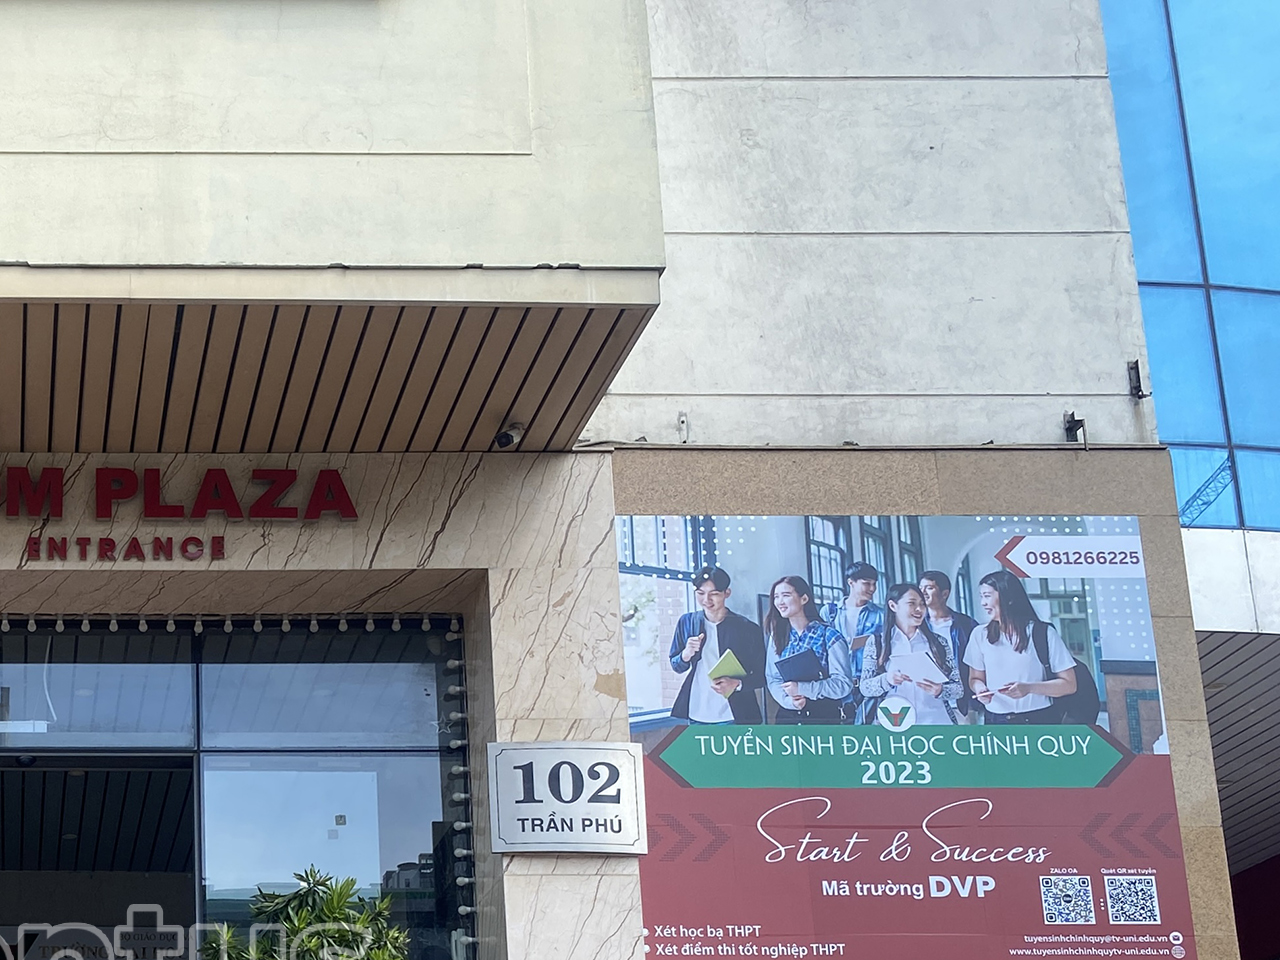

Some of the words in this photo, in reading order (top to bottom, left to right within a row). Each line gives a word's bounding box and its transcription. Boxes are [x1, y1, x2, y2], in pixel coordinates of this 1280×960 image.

[96, 467, 358, 521] PLAZA
[28, 536, 225, 560] ENTRANCE
[1026, 551, 1140, 565] 0981266225
[695, 728, 773, 755] TUYỂN
[781, 736, 834, 755] SINH
[841, 736, 882, 759] ĐẠI
[889, 736, 946, 759] HỌC
[952, 732, 1030, 755] CHÍNH
[1037, 736, 1091, 757] QUY
[513, 761, 621, 804] 102
[860, 761, 932, 784] 2023
[516, 811, 573, 833] TRẦN
[582, 815, 623, 833] PHÚ
[757, 796, 869, 862] Start
[879, 831, 911, 861] &
[922, 798, 1052, 862] Success
[823, 880, 850, 896] Mã
[855, 880, 924, 900] trường
[929, 876, 995, 898] DVP
[654, 925, 677, 937] Xét
[680, 925, 704, 940] học
[707, 925, 724, 939] bạ
[726, 925, 761, 937] THPT
[655, 943, 678, 955] Xét
[681, 941, 714, 955] điểm
[717, 943, 736, 955] thi
[738, 942, 758, 955] tốt
[761, 942, 808, 958] nghiệp
[810, 943, 845, 956] THPT
